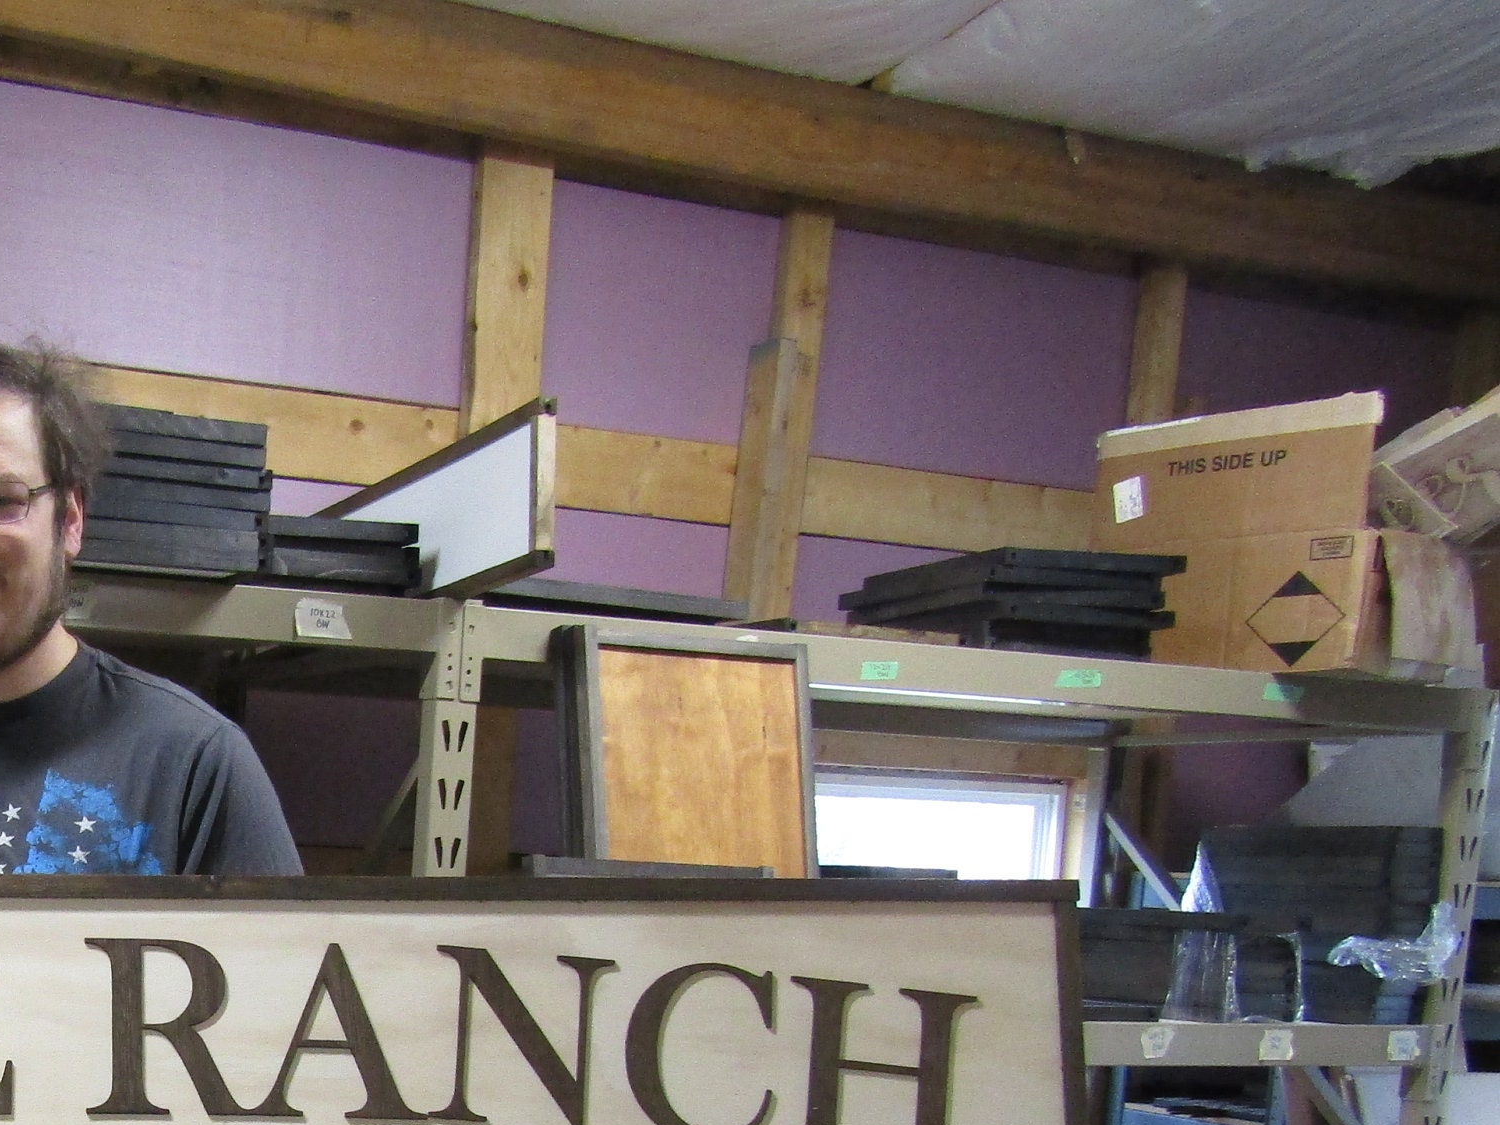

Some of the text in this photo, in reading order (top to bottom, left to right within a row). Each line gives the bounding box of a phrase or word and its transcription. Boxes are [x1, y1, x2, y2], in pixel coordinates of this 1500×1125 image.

[1167, 449, 1287, 476] THIS SIDE UP
